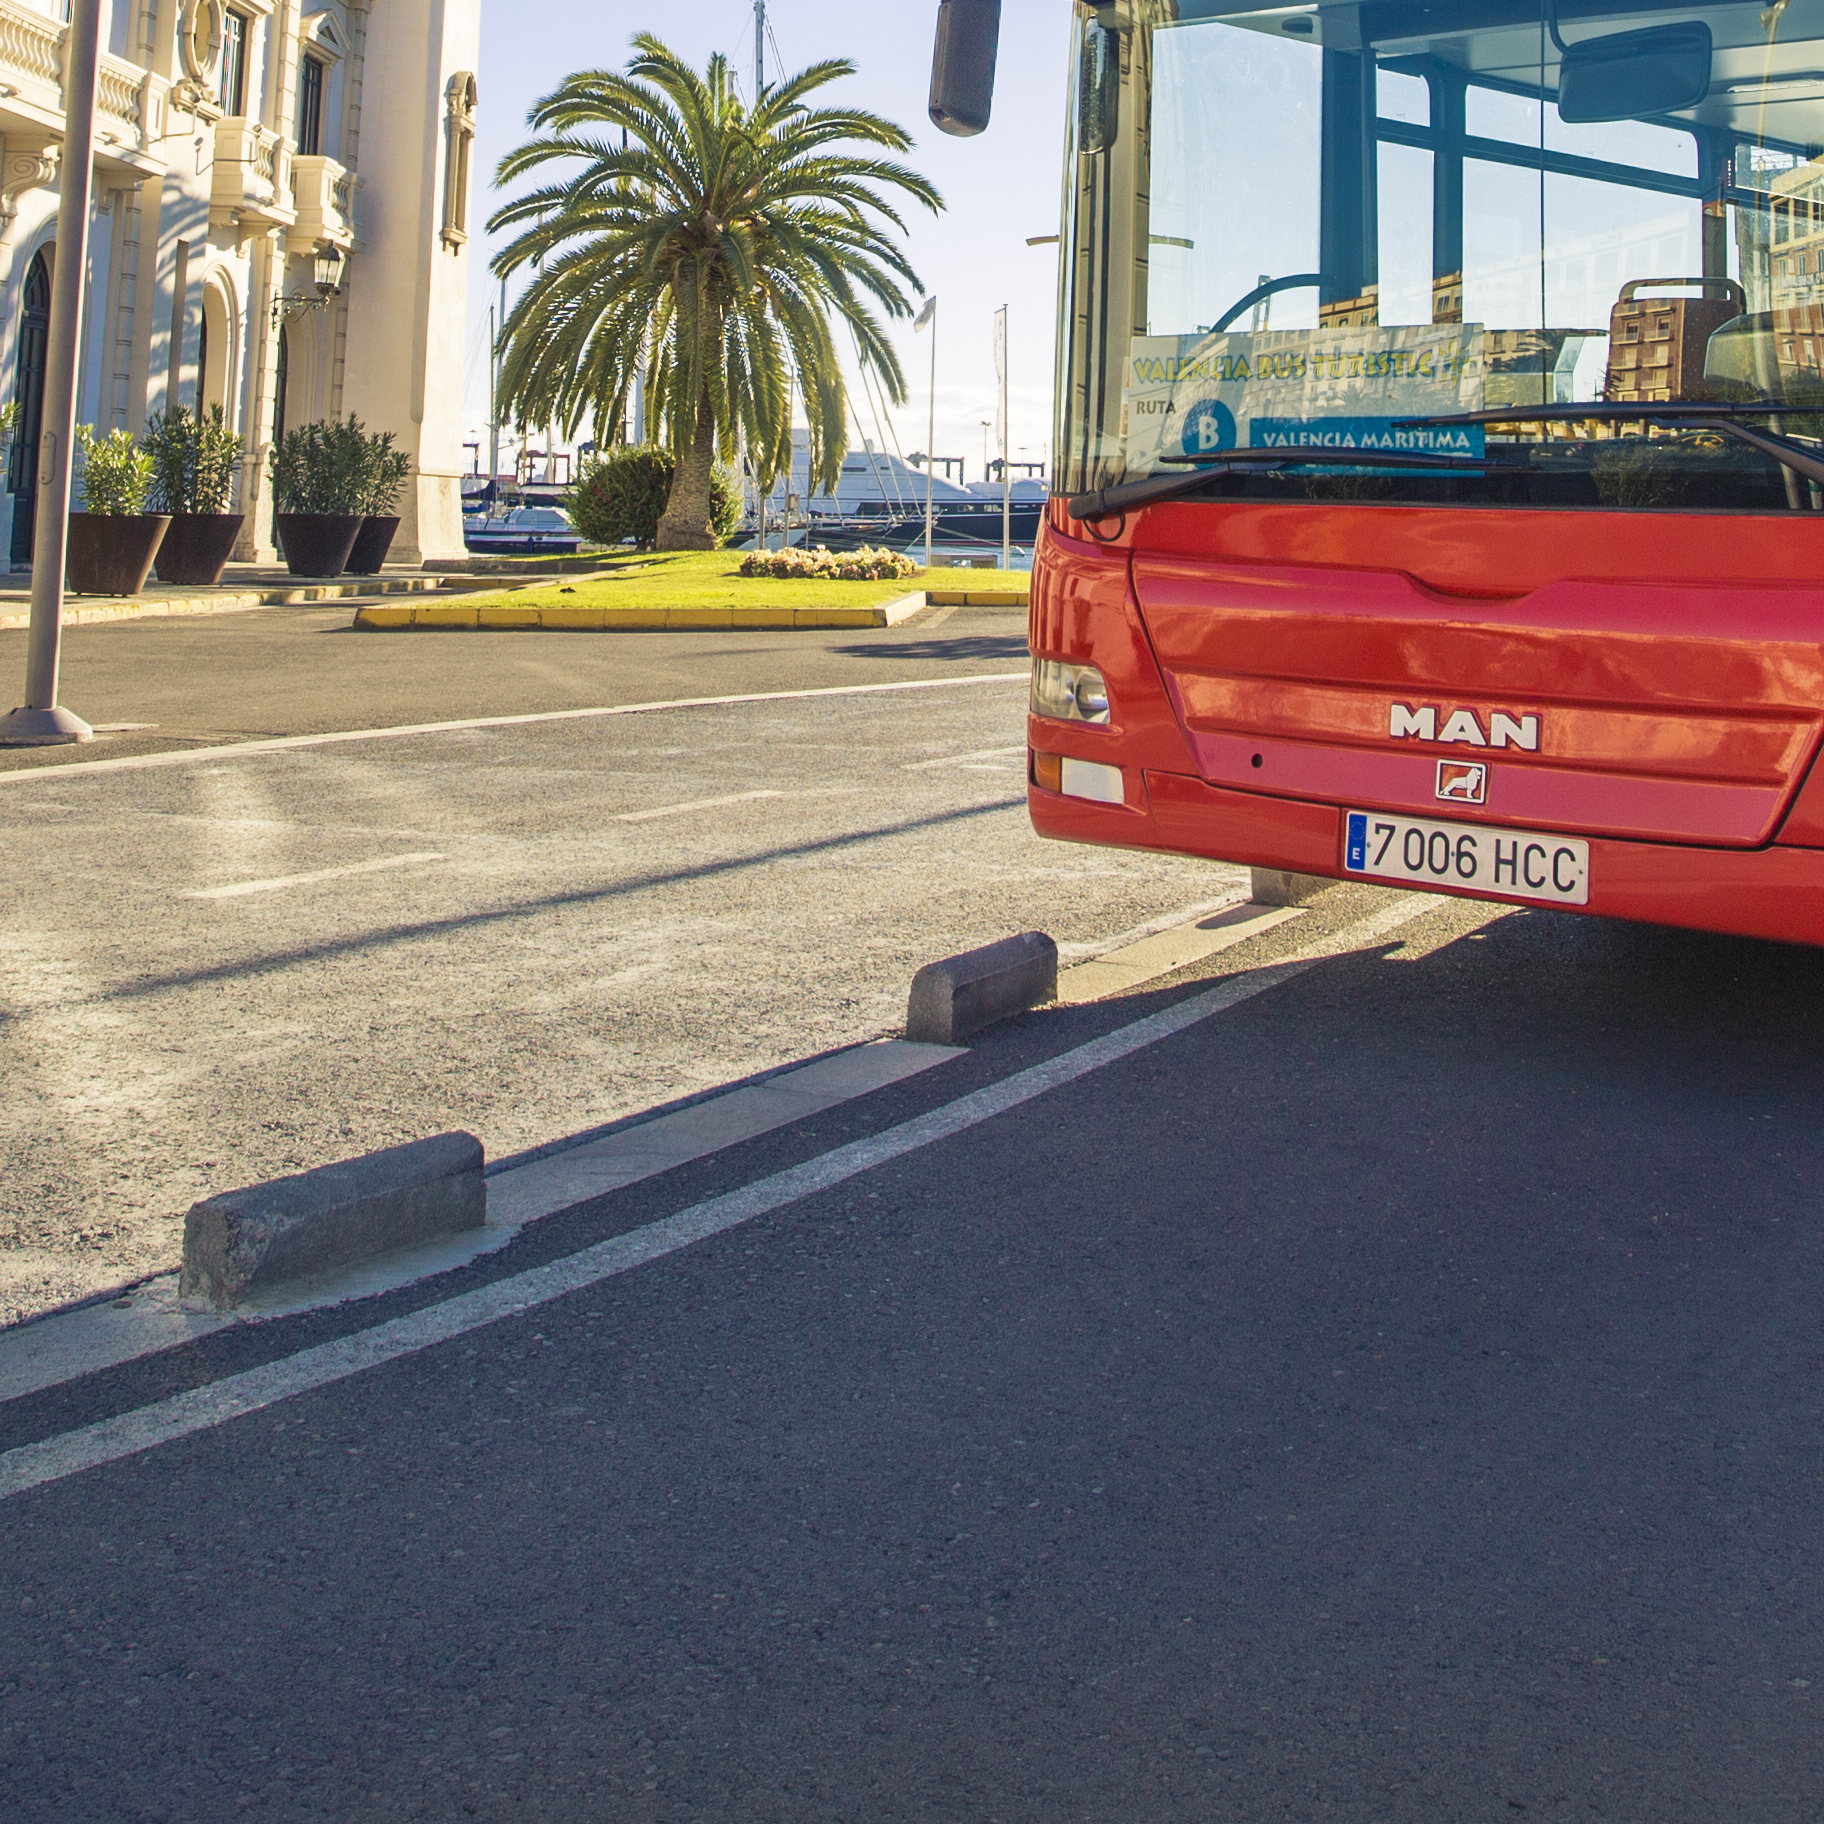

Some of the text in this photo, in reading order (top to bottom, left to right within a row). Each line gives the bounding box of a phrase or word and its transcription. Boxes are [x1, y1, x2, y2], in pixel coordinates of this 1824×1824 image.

[1132, 351, 1435, 384] VALENCIA BUS TURISTIC
[1136, 399, 1177, 416] RUTA
[1197, 414, 1219, 449] B
[1262, 430, 1471, 449] VALENCIA MARITIMA
[1389, 702, 1540, 751] MAN
[1352, 847, 1361, 861] E
[1373, 823, 1577, 893] 7006 HCC
